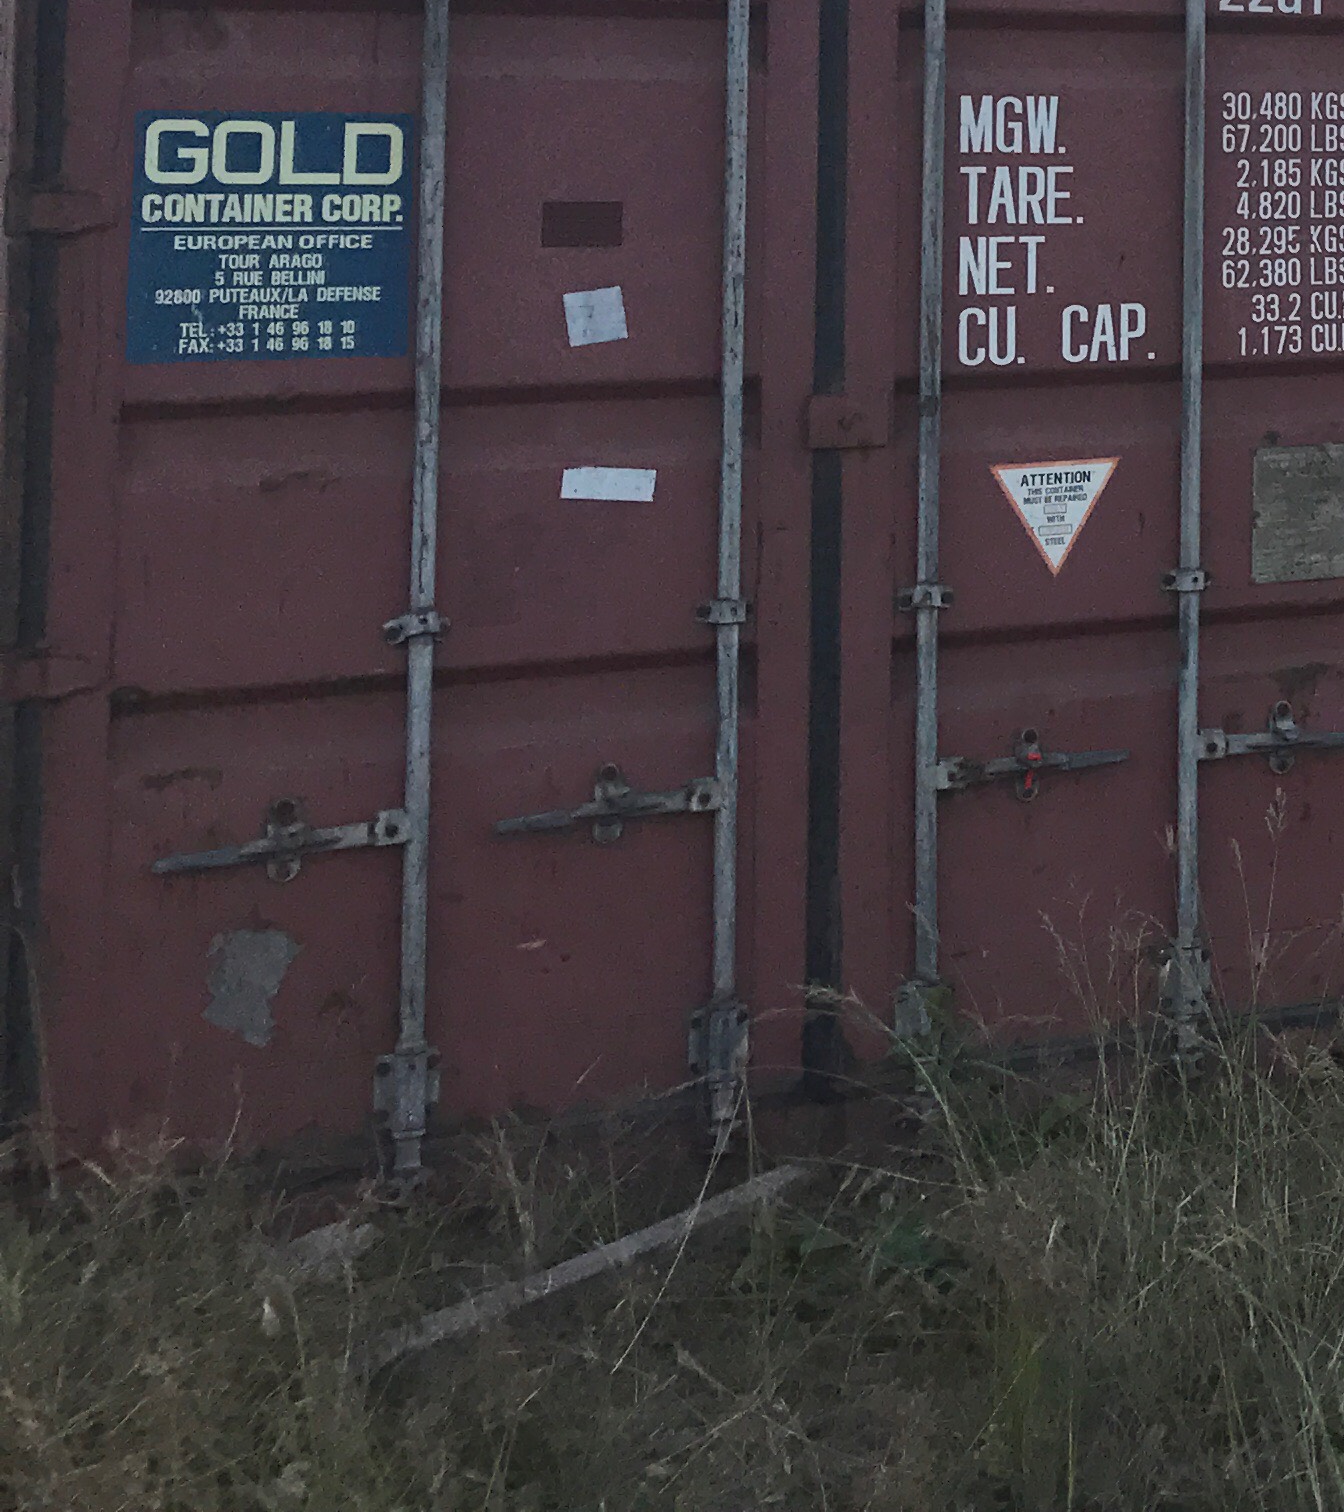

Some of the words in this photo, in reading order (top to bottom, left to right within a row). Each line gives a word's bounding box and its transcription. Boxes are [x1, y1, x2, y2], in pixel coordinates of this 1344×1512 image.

[1222, 92, 1301, 121] 30,480
[959, 95, 1067, 154] MGW.
[1222, 124, 1301, 153] 67,200
[145, 119, 404, 185] GOLD
[1237, 158, 1301, 188] 2,185
[142, 193, 312, 223] CONTAINER
[321, 194, 403, 222] CORP.
[960, 166, 1084, 224] TARE.
[1237, 191, 1301, 220] 4,820
[174, 235, 293, 250] EUROPEAN
[299, 235, 373, 249] OFFICE
[1222, 226, 1300, 255] 28,295
[218, 254, 260, 269] TOUR
[269, 254, 322, 268] ARAGO
[958, 236, 1055, 295] NET.
[1222, 258, 1300, 288] 62,380
[215, 272, 224, 286] 5
[233, 271, 262, 286] RUE
[271, 271, 325, 285] BELLINI
[209, 288, 308, 304] PUTEAUX/LA
[317, 287, 381, 302] DEFENSE
[1252, 293, 1301, 322] 33.2
[239, 305, 299, 320] FRANCE
[218, 322, 244, 337] +33
[253, 322, 259, 336] 1
[958, 306, 1025, 365] CU.
[1061, 303, 1156, 362] CAP.
[1238, 325, 1301, 356] 1,173
[217, 338, 243, 352] +33
[252, 338, 259, 351] 1
[1021, 471, 1091, 487] ATTENTION
